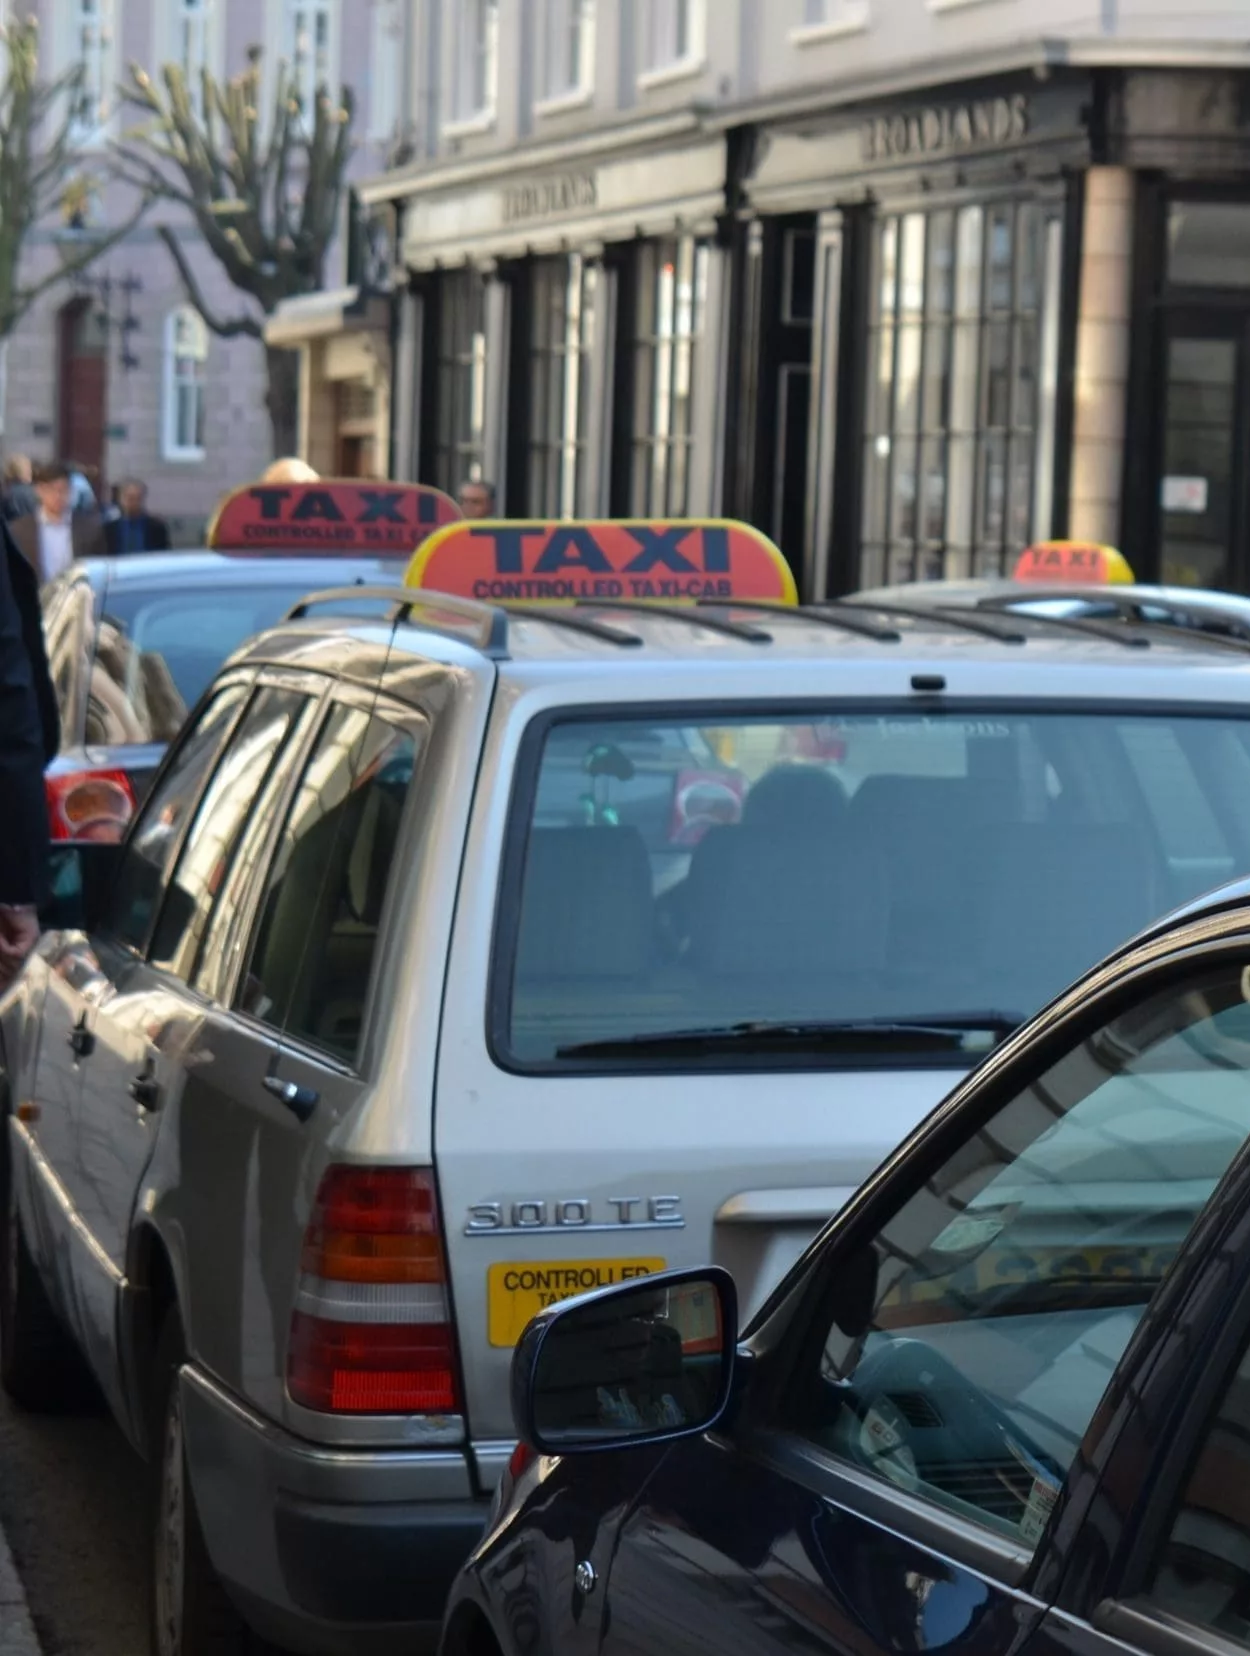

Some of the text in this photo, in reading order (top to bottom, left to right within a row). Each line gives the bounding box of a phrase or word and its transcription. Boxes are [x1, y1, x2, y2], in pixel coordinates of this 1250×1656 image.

[860, 94, 1030, 164] BROADLANDS
[249, 489, 438, 523] TAXI
[242, 524, 356, 541] CONTROLLED
[469, 526, 731, 574] TAXI
[1032, 548, 1100, 568] TAXI
[472, 579, 732, 600] CONTROLLED TAXI-CAB
[466, 1194, 683, 1229] 300 TE
